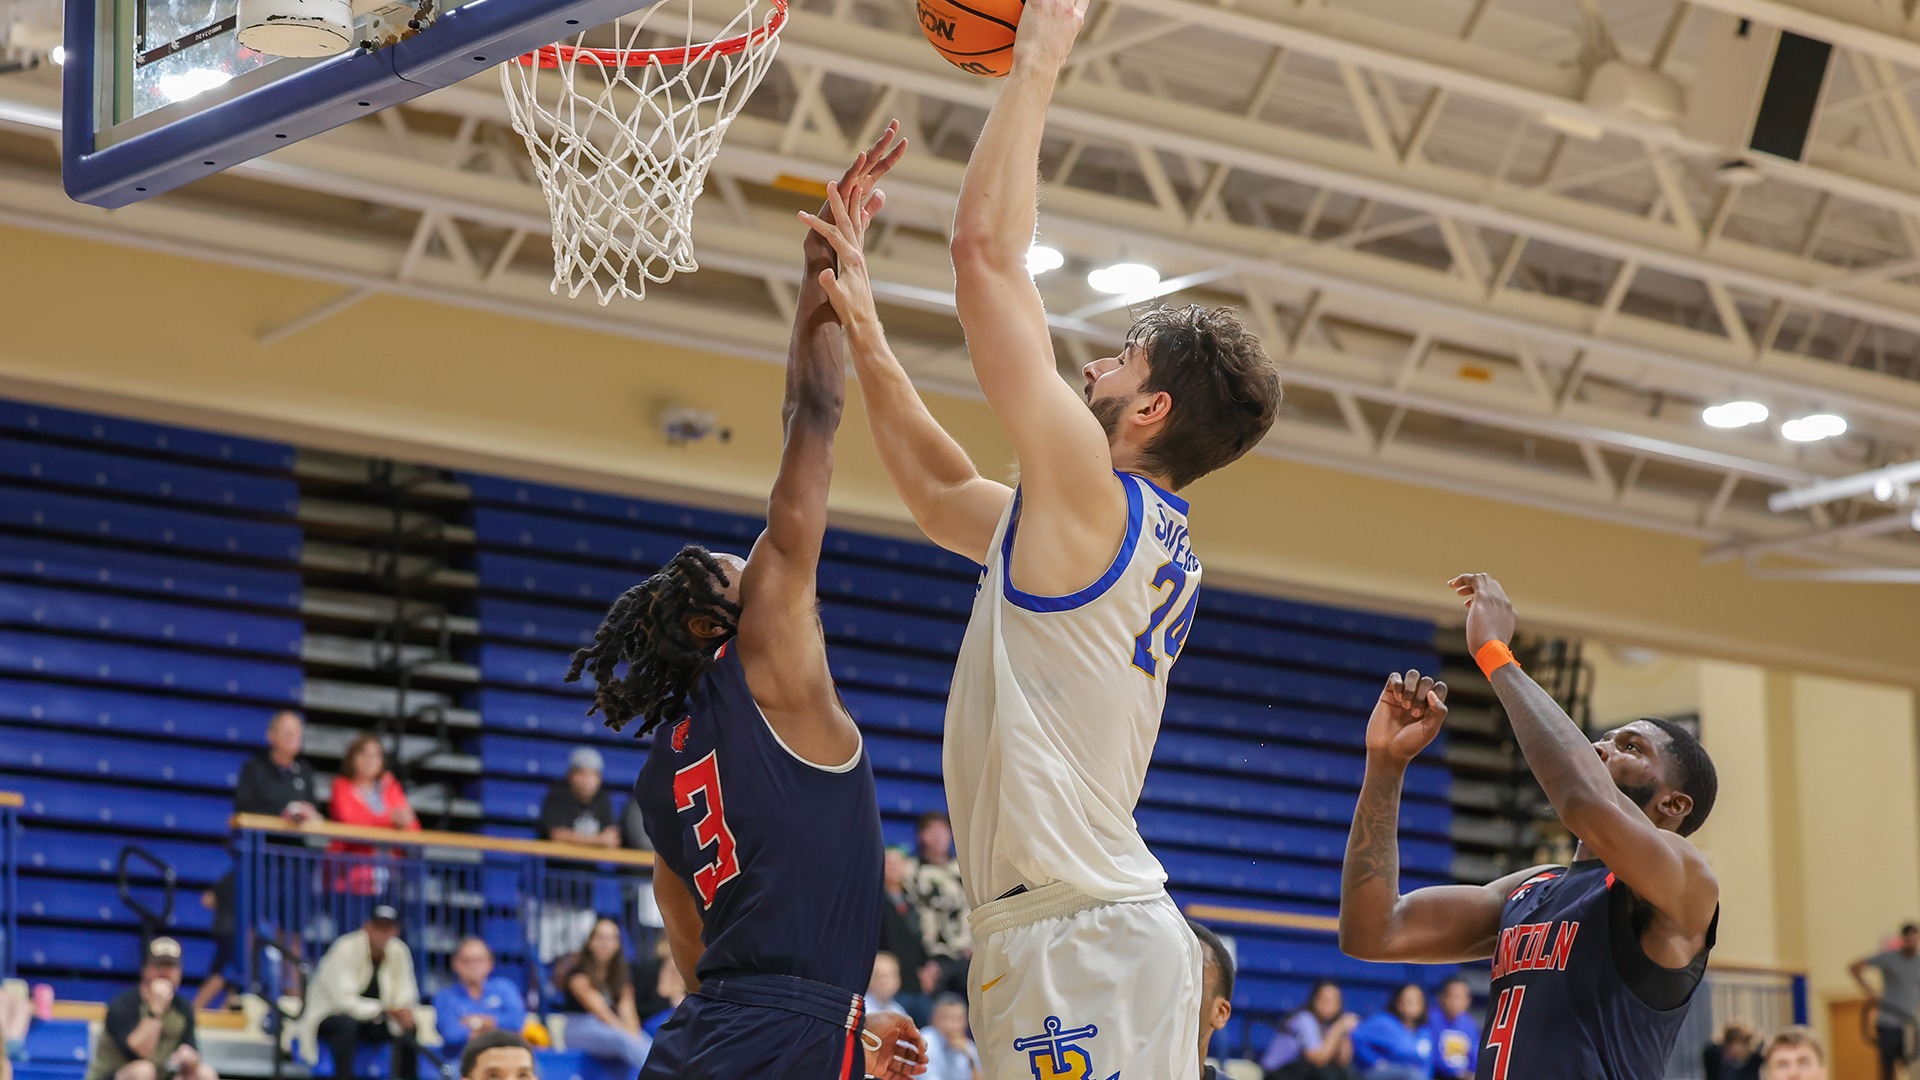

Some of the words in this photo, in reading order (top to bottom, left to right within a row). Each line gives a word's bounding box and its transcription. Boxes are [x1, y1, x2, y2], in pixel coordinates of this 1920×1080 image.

[1130, 559, 1201, 681] 24
[673, 748, 741, 911] 3
[1486, 985, 1526, 1080] 4
